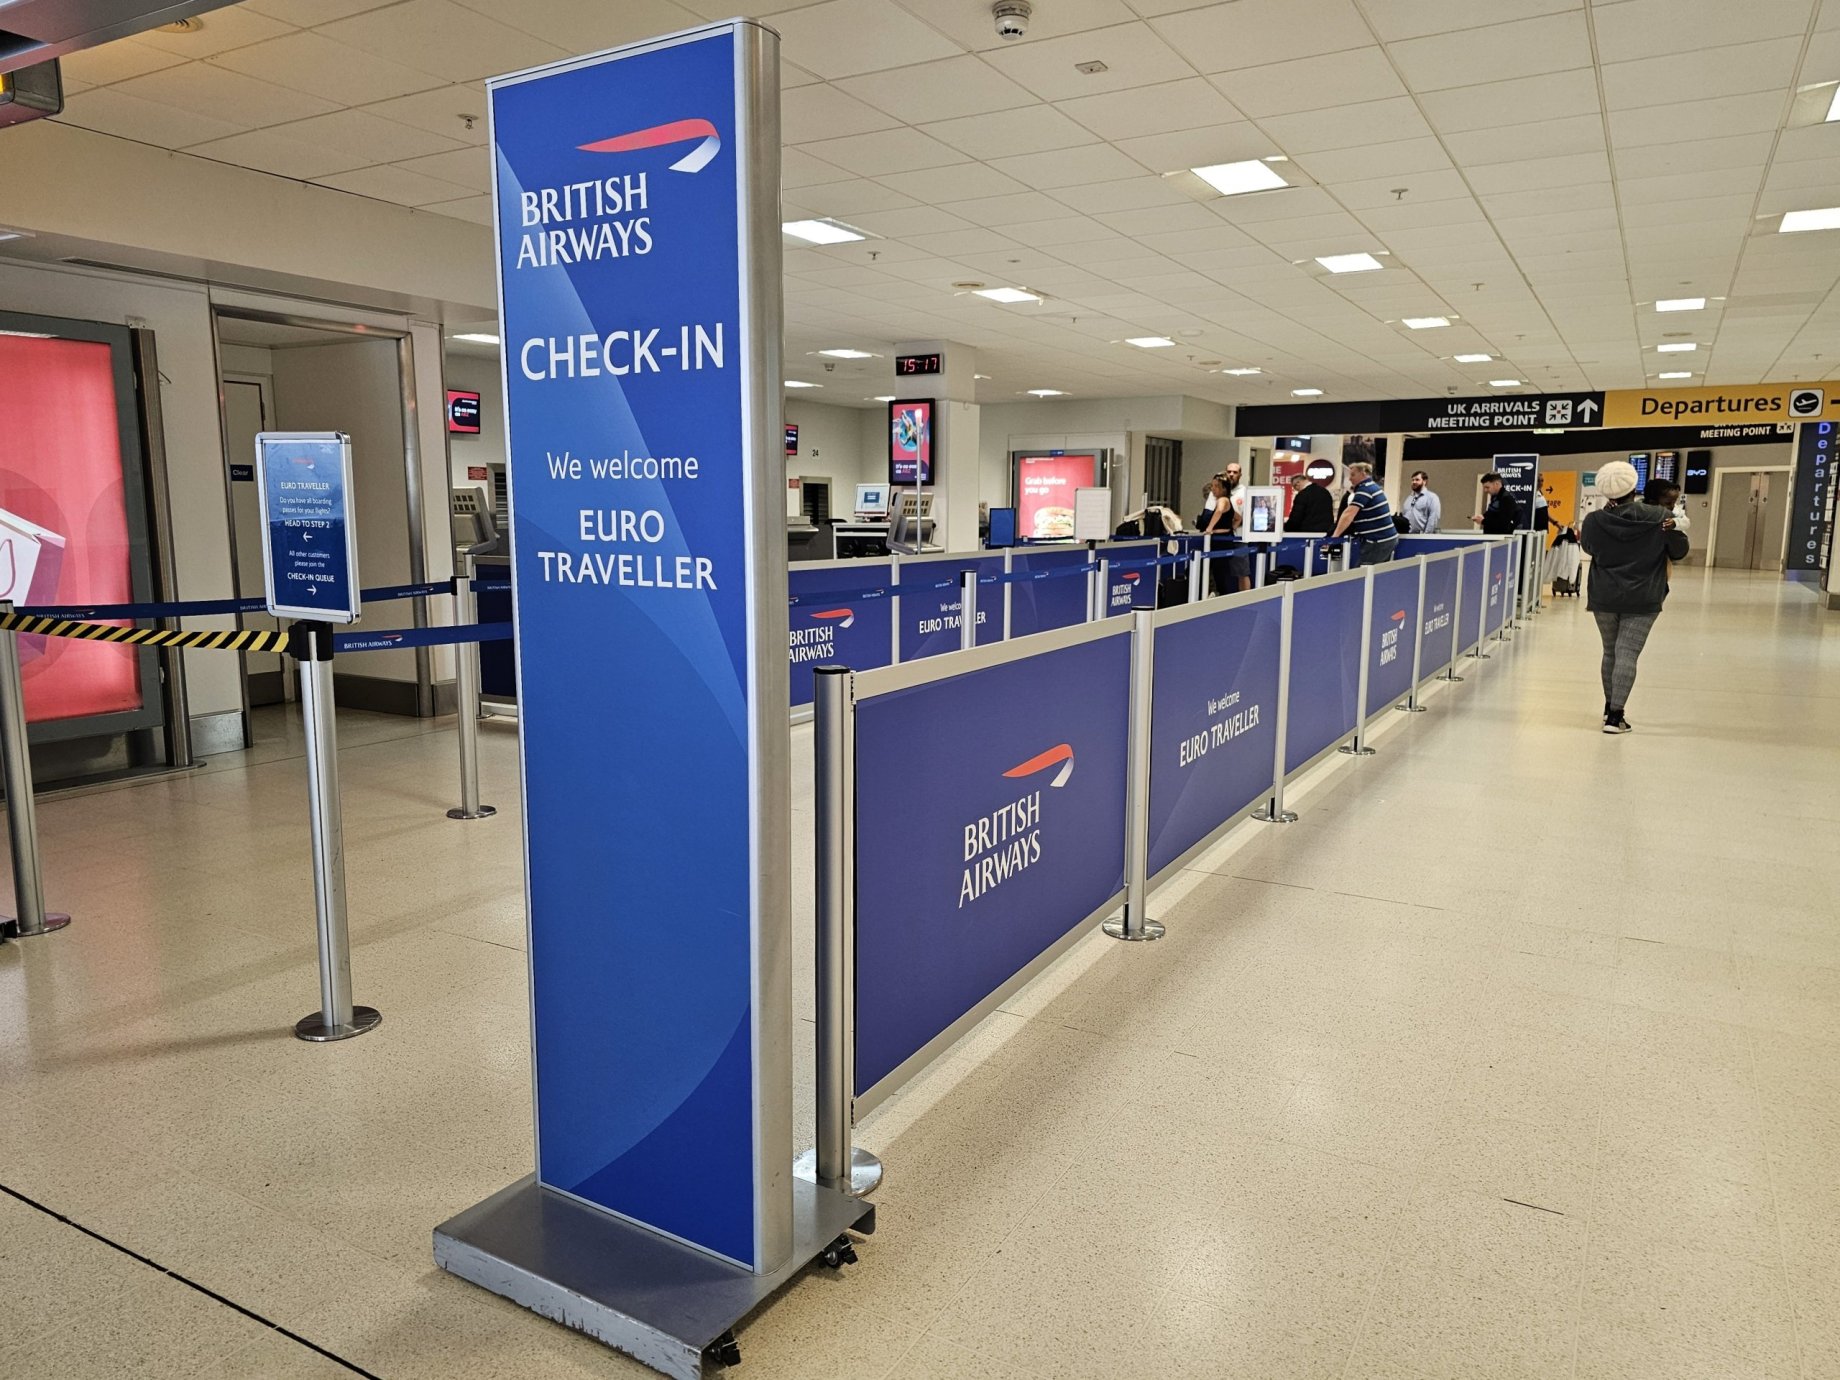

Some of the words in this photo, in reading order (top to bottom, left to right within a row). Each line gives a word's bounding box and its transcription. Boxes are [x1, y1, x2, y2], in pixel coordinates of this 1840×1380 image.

[521, 172, 648, 227] BRITISH
[516, 217, 653, 270] AIRWAYS
[521, 322, 724, 381] CHECK-IN
[1448, 404, 1466, 414] UK
[1471, 401, 1540, 413] ARRIVALS
[1642, 396, 1782, 420] Departures
[1428, 416, 1490, 428] MEETING
[1494, 415, 1537, 426] POINT
[1701, 428, 1740, 438] MEETING
[1743, 426, 1771, 436] POINT
[547, 452, 582, 480] We
[590, 450, 699, 479] welcome
[281, 482, 296, 490] EURO
[298, 482, 329, 490] TRAVELLER
[1025, 477, 1042, 485] Grab
[1043, 476, 1066, 485] before
[1025, 487, 1038, 495] you
[1040, 487, 1049, 495] go
[1806, 423, 1831, 564] Departures
[580, 509, 664, 543] EURO
[288, 572, 314, 580] CHECK-IN
[315, 574, 335, 582] QUEUE
[538, 551, 718, 590] TRAVELLER
[1113, 584, 1131, 596] BRITISH
[949, 602, 961, 610] welco
[1111, 595, 1131, 607] AIRWAYS
[790, 626, 833, 646] BRITISH
[920, 618, 942, 634] EURO
[368, 640, 392, 648] AIRWAYS
[789, 642, 834, 663] AIRWAYS
[1208, 700, 1216, 716] We
[1217, 690, 1240, 712] welcome
[1180, 730, 1208, 768] EURO
[1211, 705, 1259, 748] TRAVELLER
[964, 791, 1040, 862] BRITISH
[959, 829, 1041, 909] AIRWAYS
